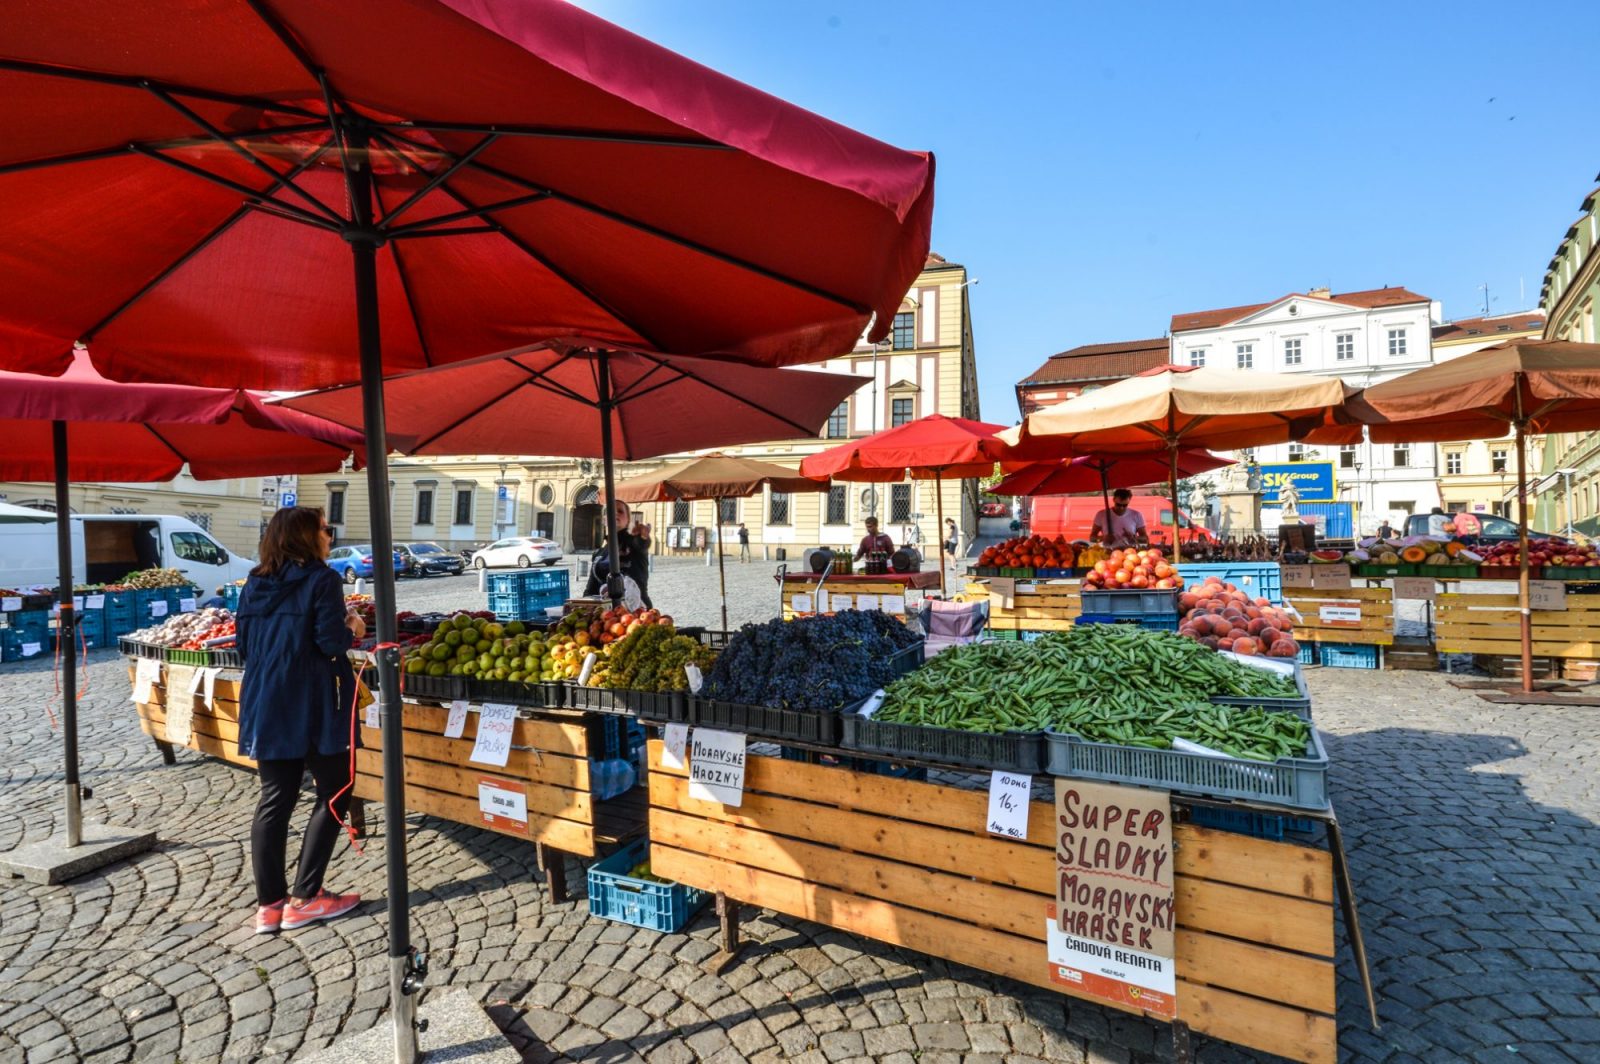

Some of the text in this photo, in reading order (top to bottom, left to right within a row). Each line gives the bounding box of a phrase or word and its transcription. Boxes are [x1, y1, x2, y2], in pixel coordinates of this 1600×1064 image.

[1260, 473, 1289, 487] SK
[284, 494, 294, 506] P
[692, 764, 740, 787] HROZNY
[1060, 789, 1165, 839] SUPER
[1057, 832, 1167, 881] SLADKÝ
[1060, 872, 1176, 931] MORAVSKÝ
[1062, 908, 1153, 950] HRÁŠEK
[1065, 936, 1112, 960] ČADOVÁ
[1115, 950, 1163, 973] RENATA
